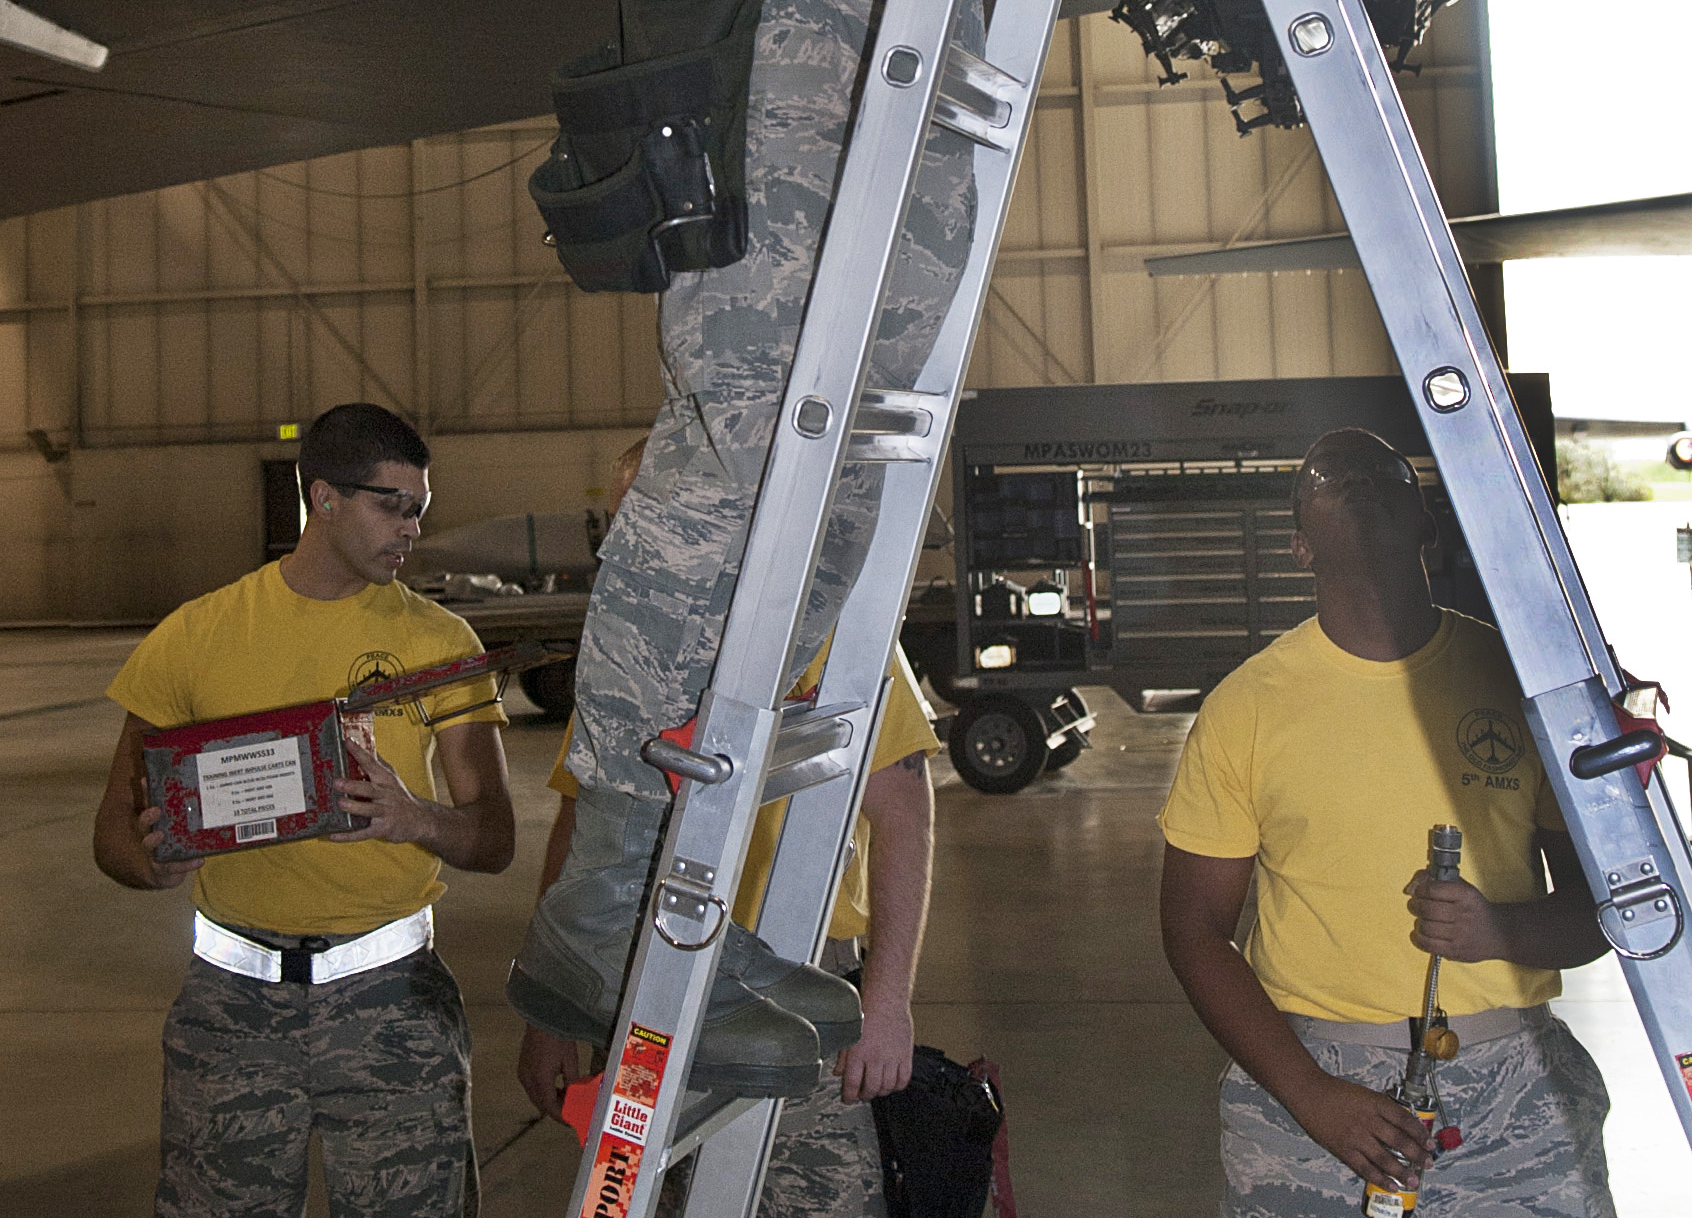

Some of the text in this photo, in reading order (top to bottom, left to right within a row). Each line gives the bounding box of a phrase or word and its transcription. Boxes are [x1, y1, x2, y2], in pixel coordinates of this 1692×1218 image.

[1024, 442, 1151, 460] MPASWOM23
[1462, 773, 1520, 791] 5th AMXS
[633, 1027, 667, 1045] CAUTION
[613, 1099, 648, 1124] Little
[610, 1114, 646, 1136] Giant
